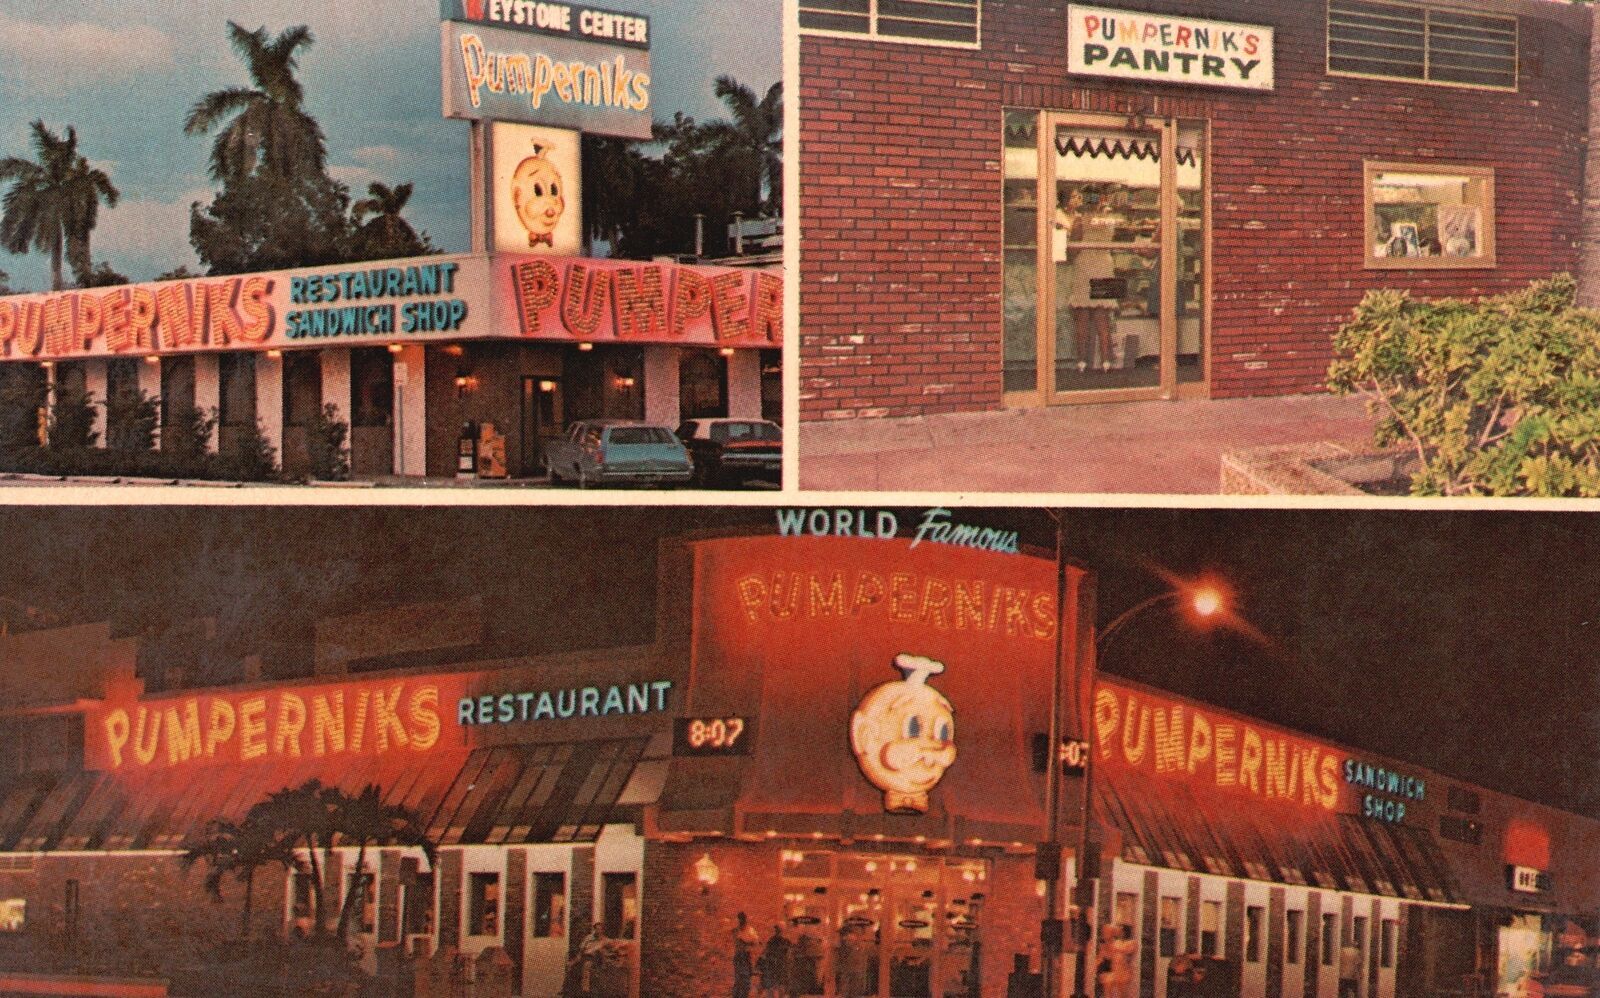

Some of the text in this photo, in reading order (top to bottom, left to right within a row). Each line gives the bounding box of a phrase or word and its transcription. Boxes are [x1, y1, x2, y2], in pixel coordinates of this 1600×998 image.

[580, 10, 647, 42] CENTER
[1084, 15, 1260, 55] PUMPERNIK'S
[460, 33, 650, 110] Pumperniks
[1084, 43, 1260, 80] PANTRY
[291, 262, 458, 304] RESTAURANT
[0, 276, 277, 356] PUMPERNIKS
[285, 298, 468, 338] SANDWICH SHOP
[776, 507, 1021, 554] WORLD Famous
[738, 569, 1058, 640] PUMPERNIKS
[458, 681, 671, 725] RESTAURANT
[104, 684, 442, 768] PUMPERNIKS
[690, 718, 744, 749] 8:07
[1095, 688, 1338, 809] PUMPERNIKS
[1344, 759, 1425, 800] SANDWICH
[1364, 794, 1406, 822] SHOP
